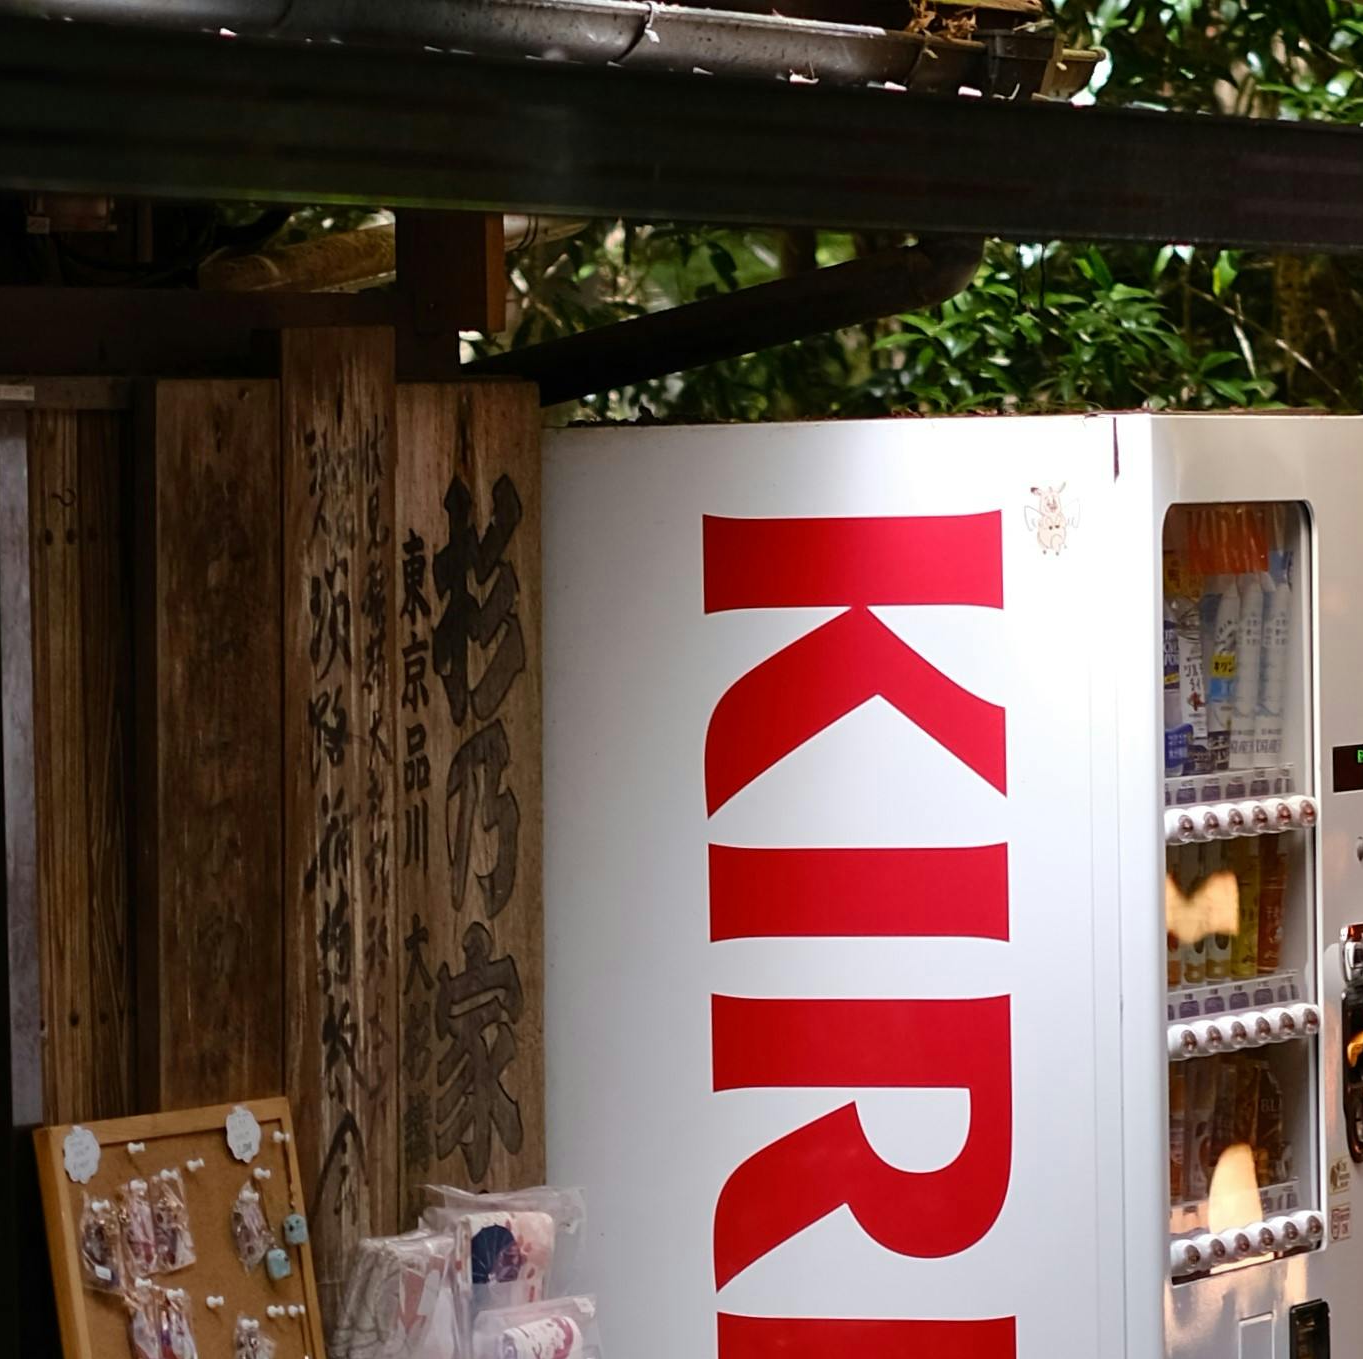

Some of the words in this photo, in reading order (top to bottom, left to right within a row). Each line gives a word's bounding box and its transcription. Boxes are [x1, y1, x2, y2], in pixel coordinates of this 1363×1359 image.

[399, 529, 431, 877] 東京品川
[433, 473, 526, 1184] 杉乃家
